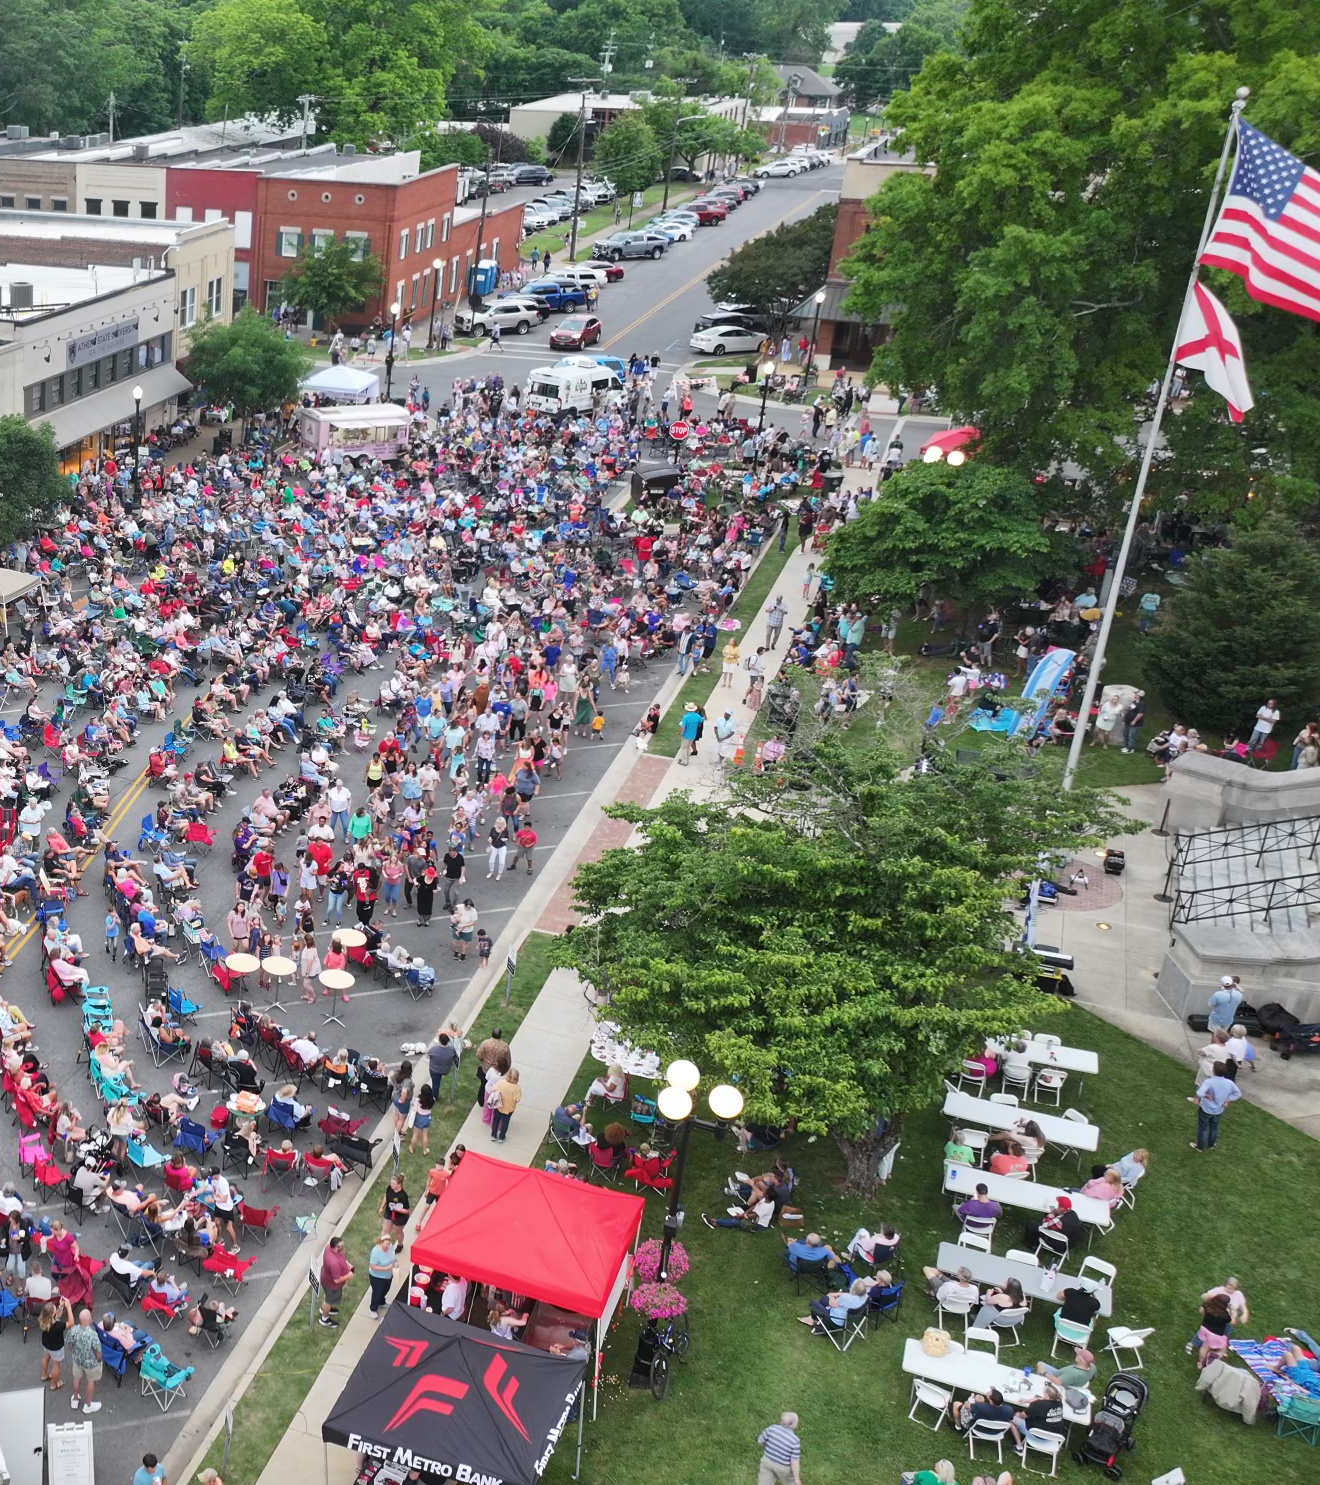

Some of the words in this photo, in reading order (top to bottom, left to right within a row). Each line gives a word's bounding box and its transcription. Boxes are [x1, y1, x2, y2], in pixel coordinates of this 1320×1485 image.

[78, 338, 96, 351] ATHE
[97, 332, 111, 345] STATE
[671, 426, 688, 435] STOP
